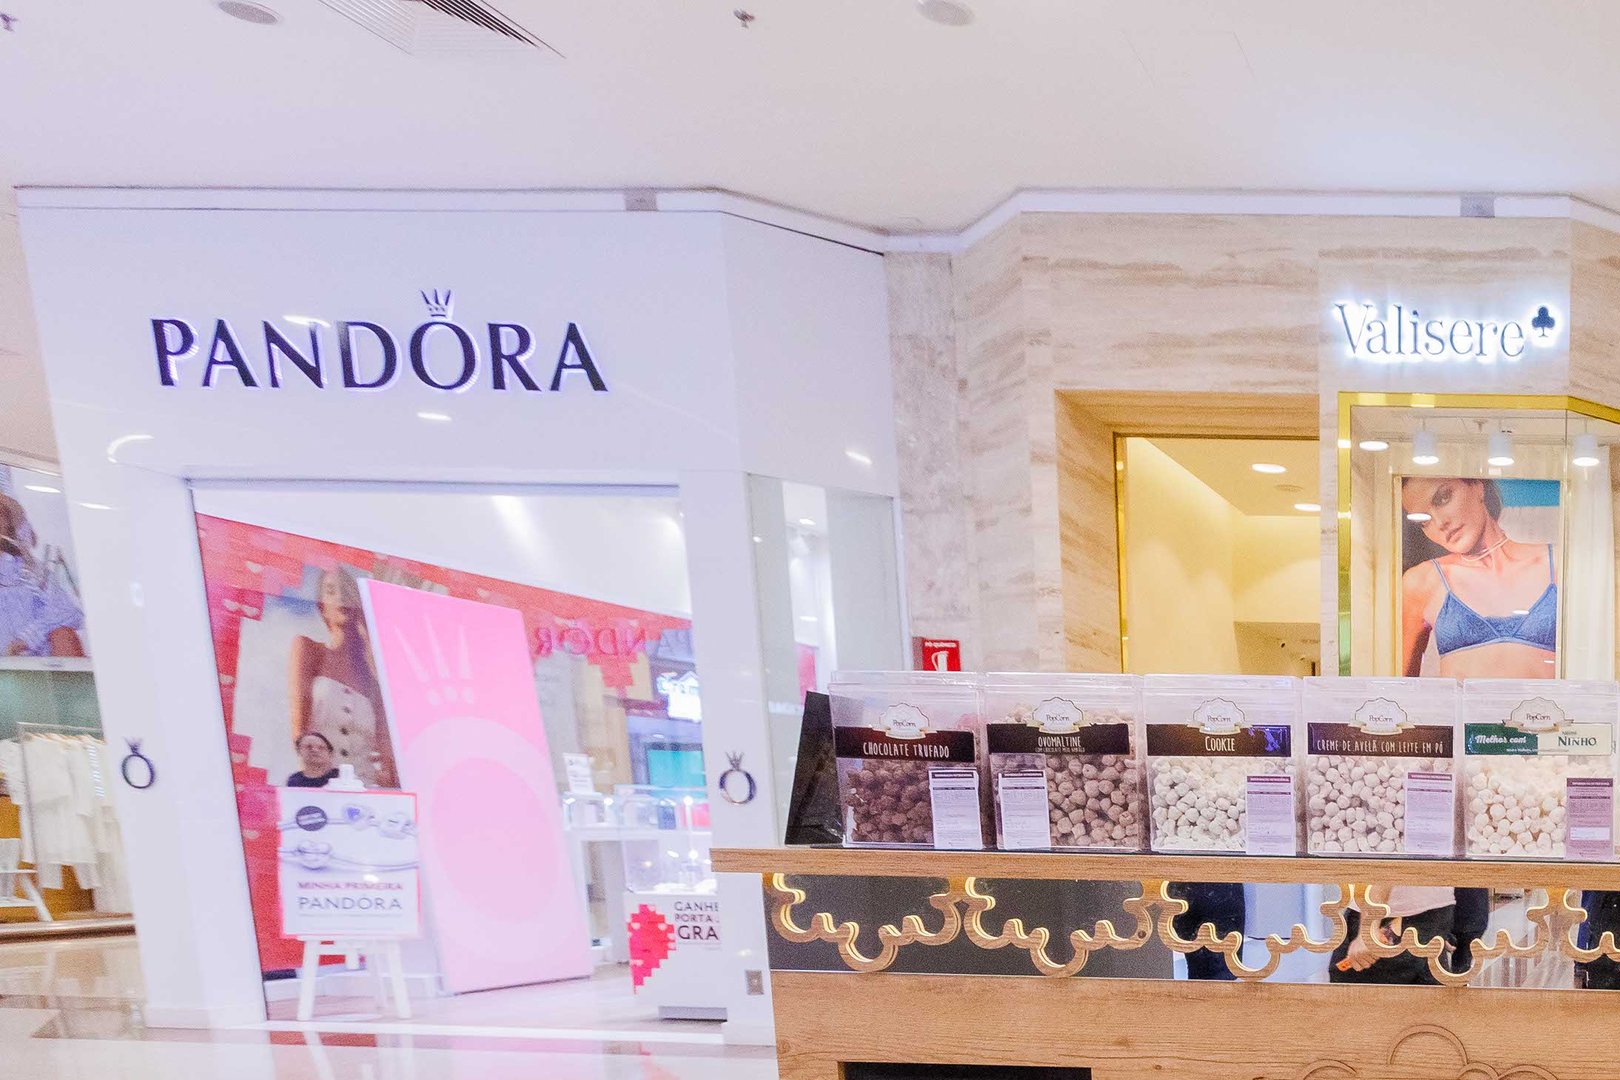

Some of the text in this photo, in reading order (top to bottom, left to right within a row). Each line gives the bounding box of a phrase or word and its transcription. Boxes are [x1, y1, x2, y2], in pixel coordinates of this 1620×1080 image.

[1334, 303, 1526, 357] Valisere
[150, 317, 609, 393] PANDORA
[1046, 714, 1070, 722] PopCorn
[1207, 715, 1231, 723] PopCorn
[1368, 715, 1393, 723] PopCorn
[1526, 713, 1551, 723] PopCorn
[1037, 735, 1081, 748] OVOMALTINE
[1475, 734, 1527, 744] Melhor com
[1558, 735, 1597, 747] NINHO
[862, 742, 950, 759] CHOCOLATE TRUFADO
[1316, 739, 1339, 751] CREME
[1342, 740, 1351, 752] DE
[1354, 739, 1378, 752] AVELÃ
[1381, 741, 1396, 753] COM
[1398, 741, 1419, 753] LEITE
[1422, 742, 1432, 754] EM
[297, 896, 404, 911] PANDORA
